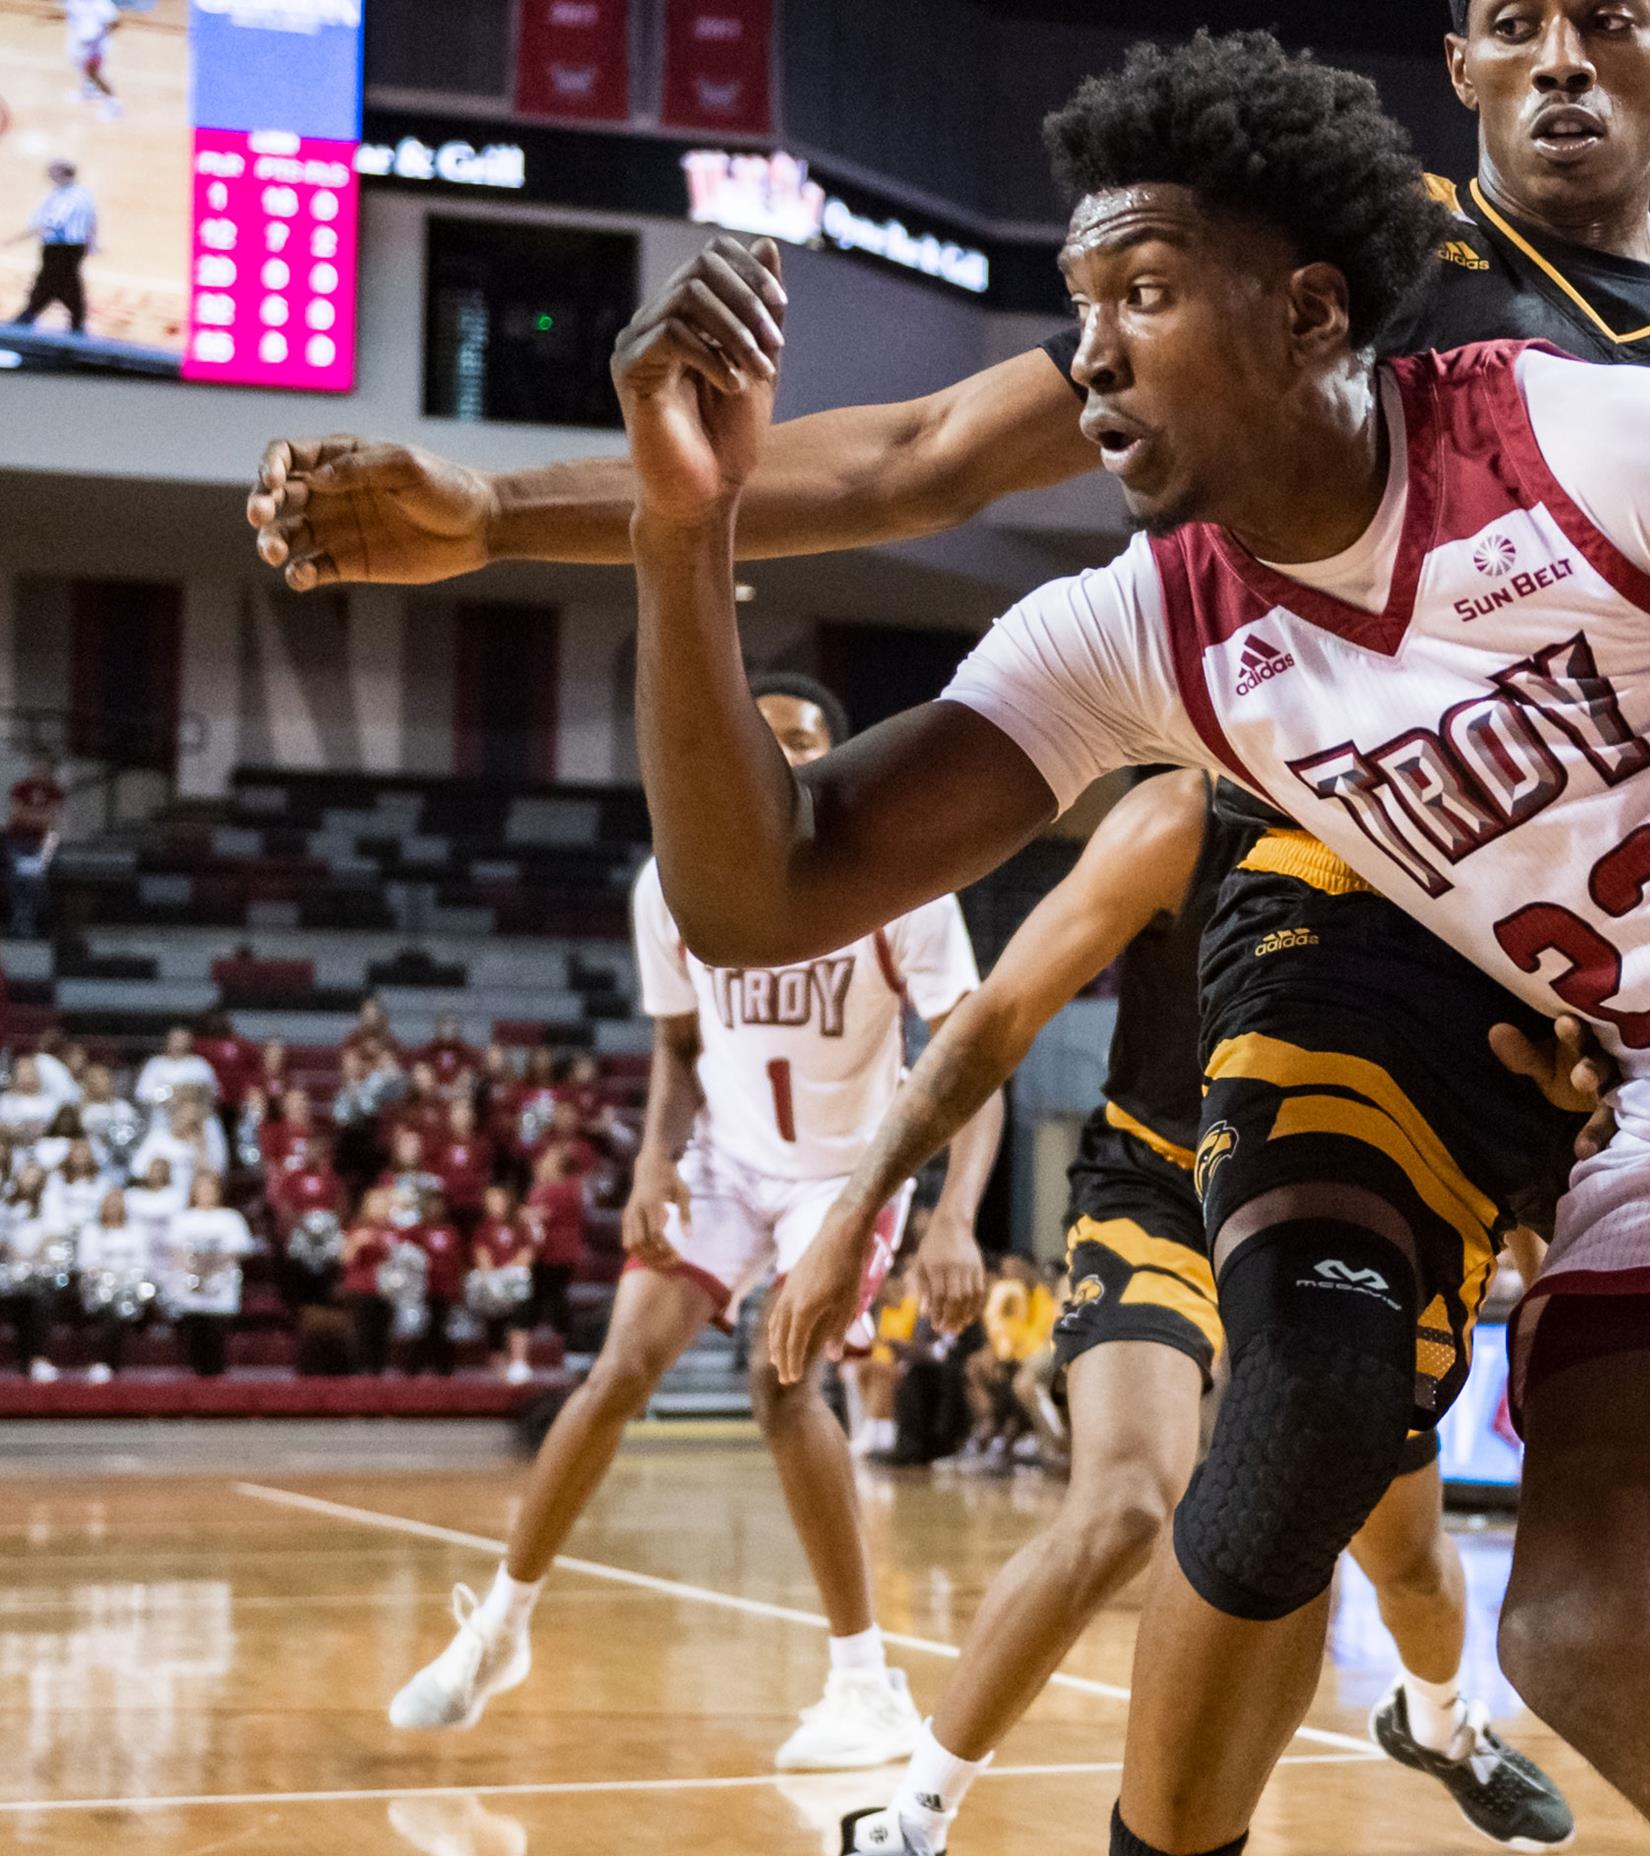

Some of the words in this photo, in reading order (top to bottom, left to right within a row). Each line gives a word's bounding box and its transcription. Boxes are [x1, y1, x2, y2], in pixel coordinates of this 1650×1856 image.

[1236, 652, 1296, 696] adidas
[1254, 933, 1320, 957] adidas
[706, 956, 856, 1037] TROY
[767, 1058, 796, 1143] 1
